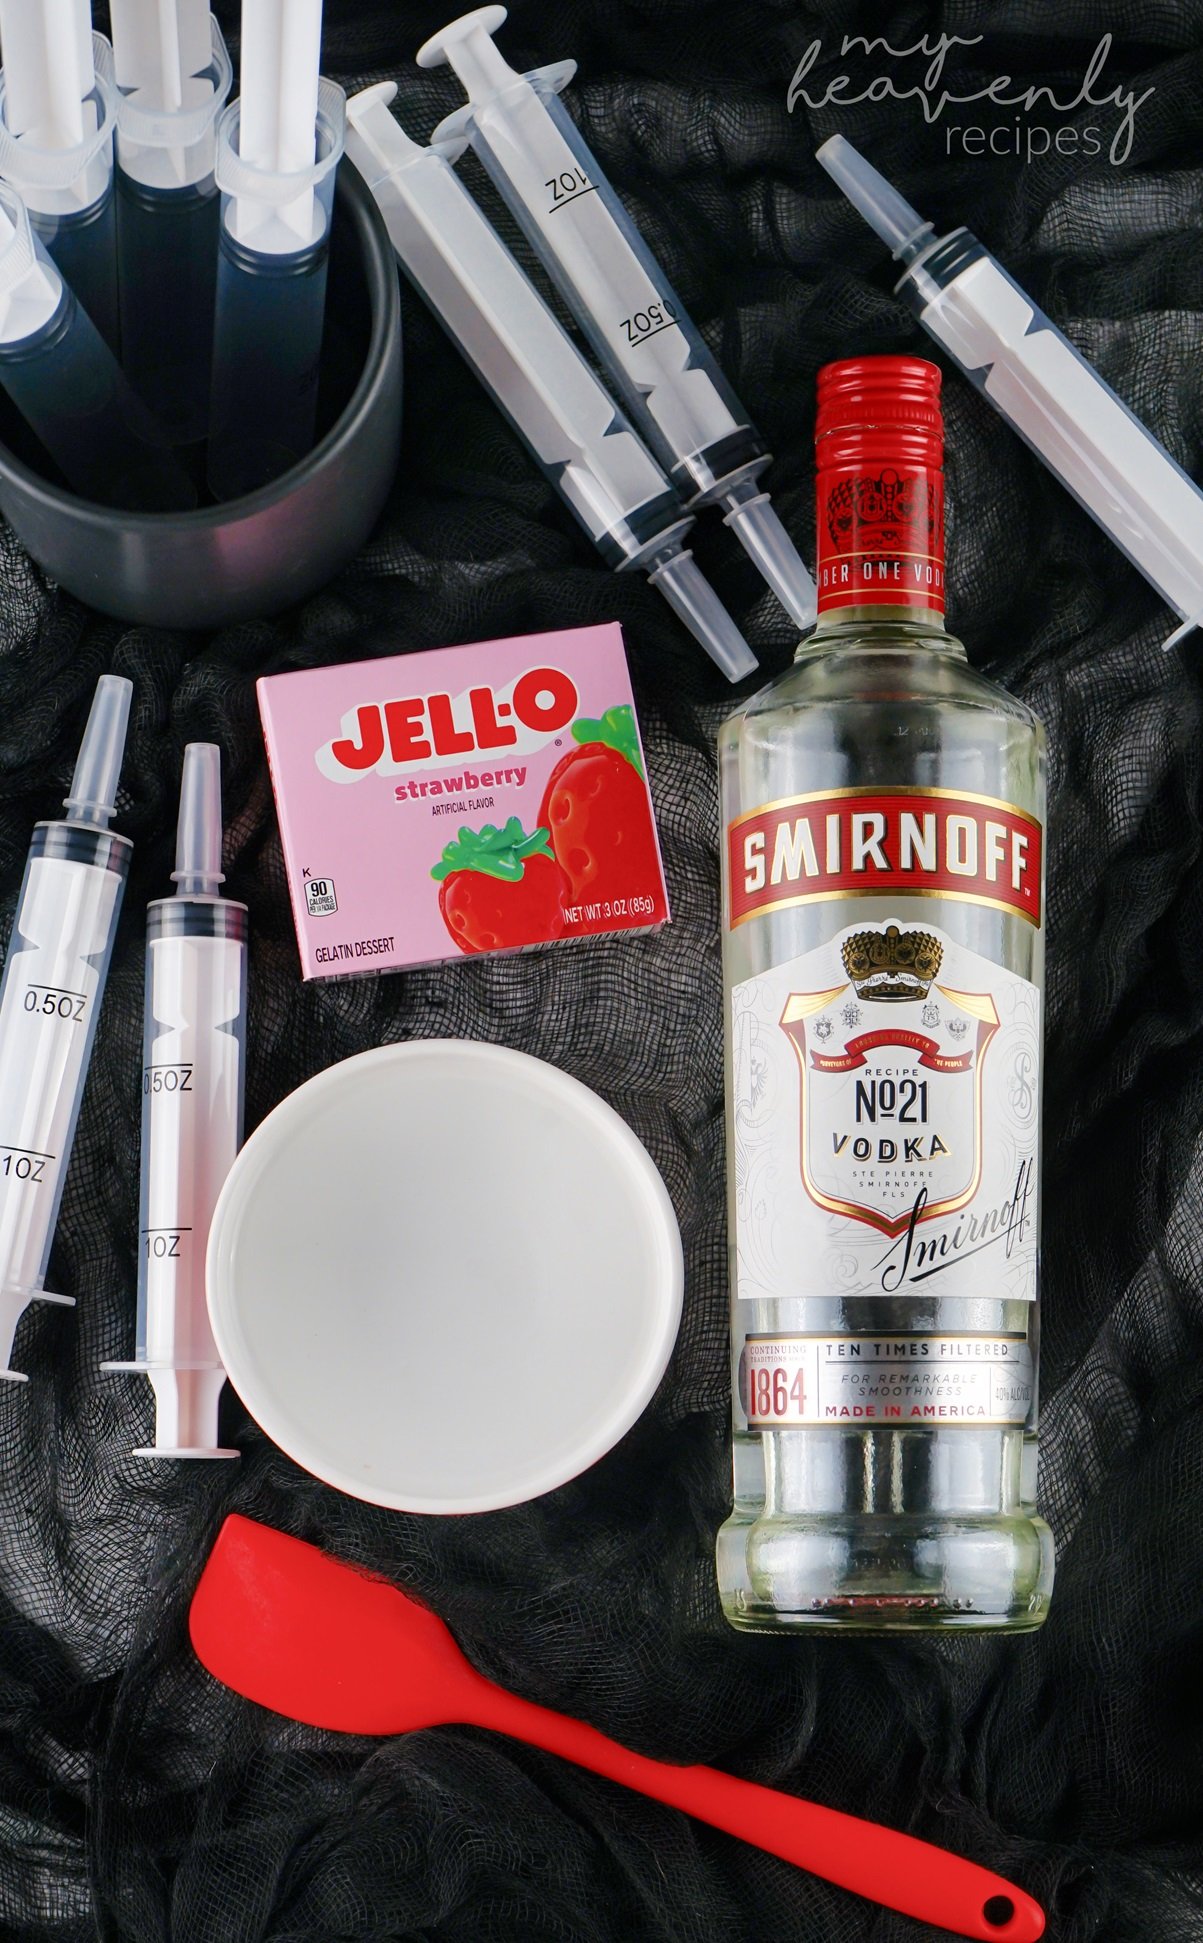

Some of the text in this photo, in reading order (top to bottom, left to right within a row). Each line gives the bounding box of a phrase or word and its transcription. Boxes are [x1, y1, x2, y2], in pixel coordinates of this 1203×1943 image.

[820, 562, 944, 588] BER ONE VOD
[331, 667, 578, 770] JELL-O
[394, 766, 527, 801] strawberry
[431, 796, 495, 817] ARTIFICIAL FLAVOR
[744, 812, 1030, 894] SMIRNOFF
[302, 867, 312, 878] K
[310, 881, 327, 897] 90
[564, 906, 583, 925] NET
[603, 902, 612, 918] 3
[611, 899, 628, 917] OZ
[315, 936, 395, 963] GELATIN DESSERT
[24, 990, 86, 1022] 0.5OZ
[864, 1068, 919, 1077] RECIPE
[832, 1132, 952, 1163] VODKA
[2, 1155, 46, 1183] 1OZ
[871, 1156, 1036, 1292] Smirnoff
[145, 1235, 181, 1259] 1OZ
[750, 1345, 807, 1355] CONTINUING
[826, 1343, 1008, 1356] TEN TIMES FILTERED
[750, 1367, 807, 1416] 1864
[841, 1374, 977, 1384] FOR REMARKABLE
[858, 1386, 963, 1397] SMOOTHNESS
[825, 1405, 986, 1417] MADE IN AMERICA
